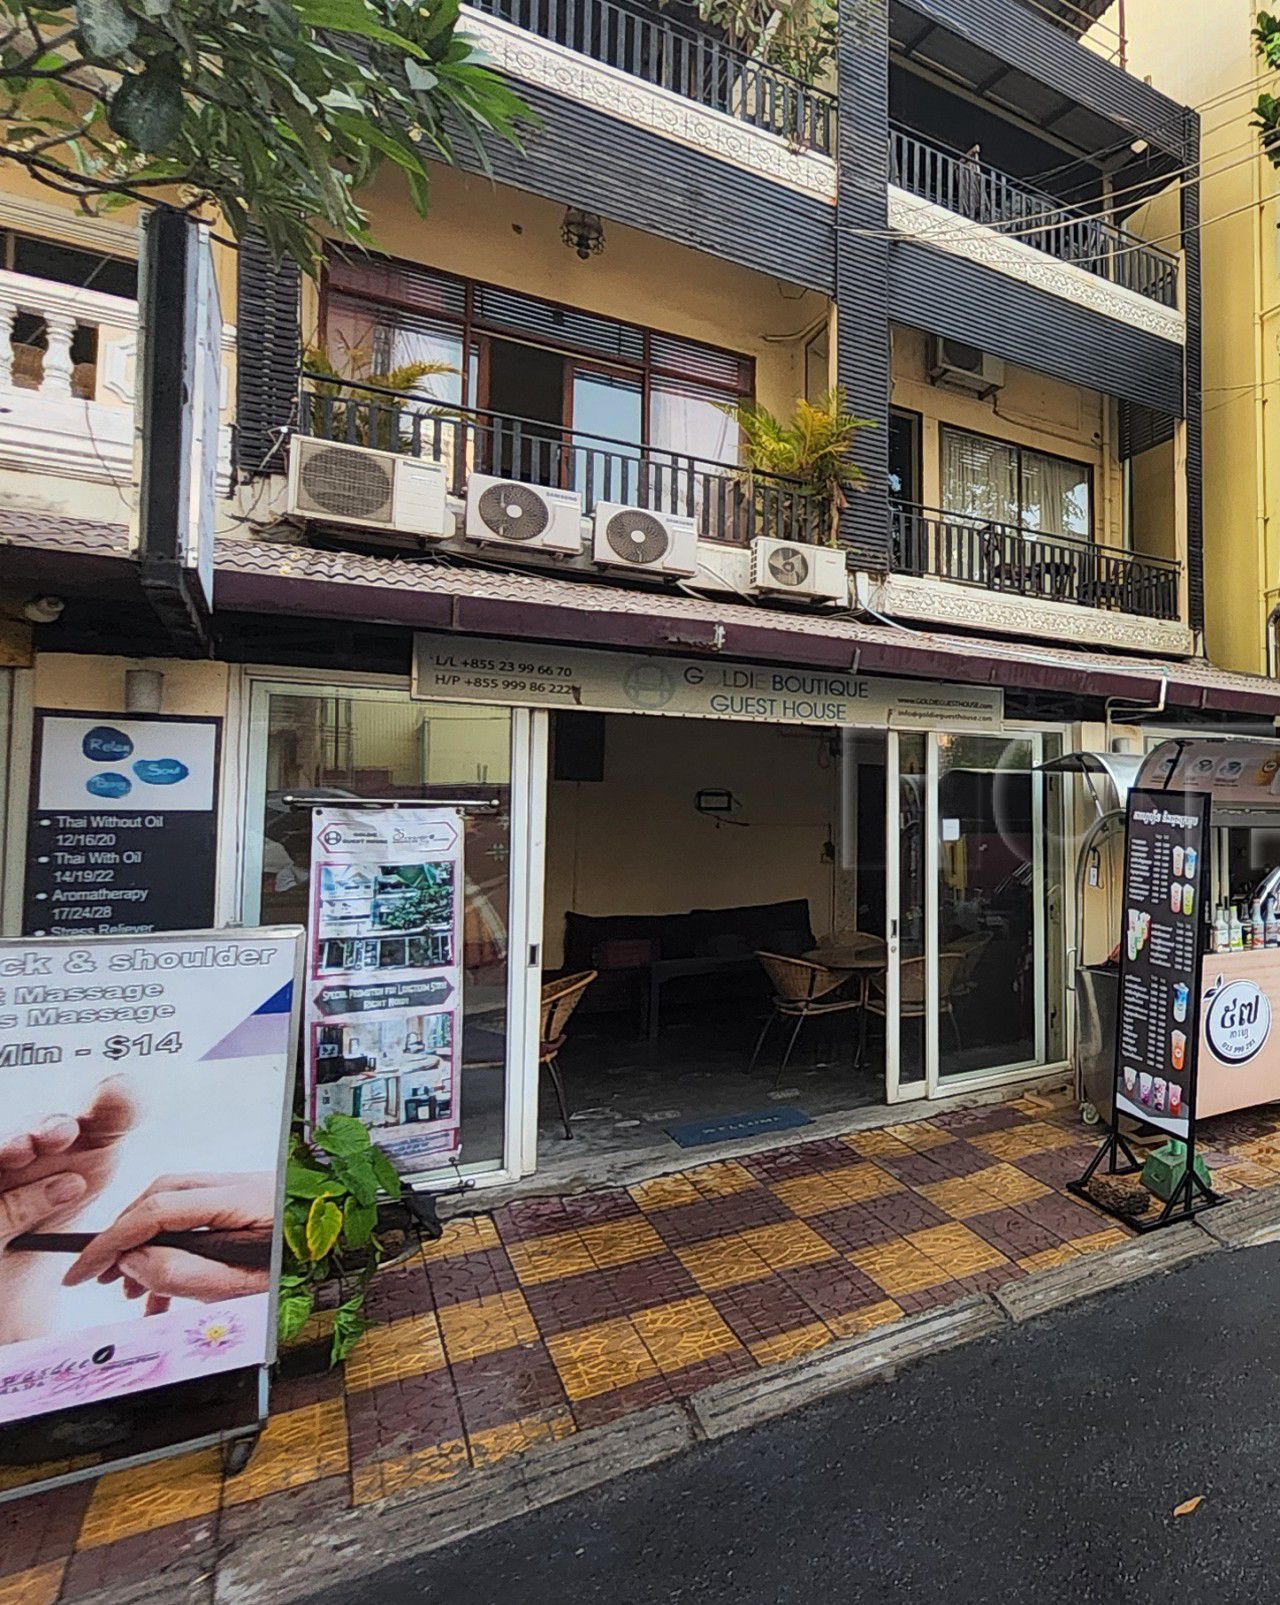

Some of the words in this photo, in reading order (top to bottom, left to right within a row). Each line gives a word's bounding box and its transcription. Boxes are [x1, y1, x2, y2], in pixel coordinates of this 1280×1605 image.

[461, 658, 495, 671] +855
[499, 660, 515, 673] 23
[518, 662, 535, 674] 99
[538, 663, 554, 675] 66
[556, 665, 572, 677] 70
[435, 674, 461, 687] H/P
[464, 677, 498, 689] +855
[502, 679, 527, 691] 999
[529, 681, 546, 693] 86
[548, 682, 571, 695] 222
[772, 675, 869, 699] BOUTIQUE
[710, 694, 777, 717] GUEST
[783, 699, 847, 720] HOUSE
[57, 815, 87, 828] Thai
[91, 815, 142, 828] Without
[145, 815, 164, 828] Oil
[55, 833, 116, 846] 12/16/20
[55, 852, 86, 865] Thai
[88, 851, 120, 864] With
[123, 851, 142, 863] Oil
[53, 869, 115, 883] 14/19/22
[51, 888, 149, 902] Aromatherapy
[52, 906, 113, 920] 17/24/28
[50, 925, 95, 935] Stress
[98, 924, 154, 934] Reliever
[64, 951, 97, 974] &
[108, 945, 278, 972] shoulder
[14, 982, 165, 1006] Massage
[26, 1003, 176, 1028] Massage
[103, 1031, 183, 1061] $14
